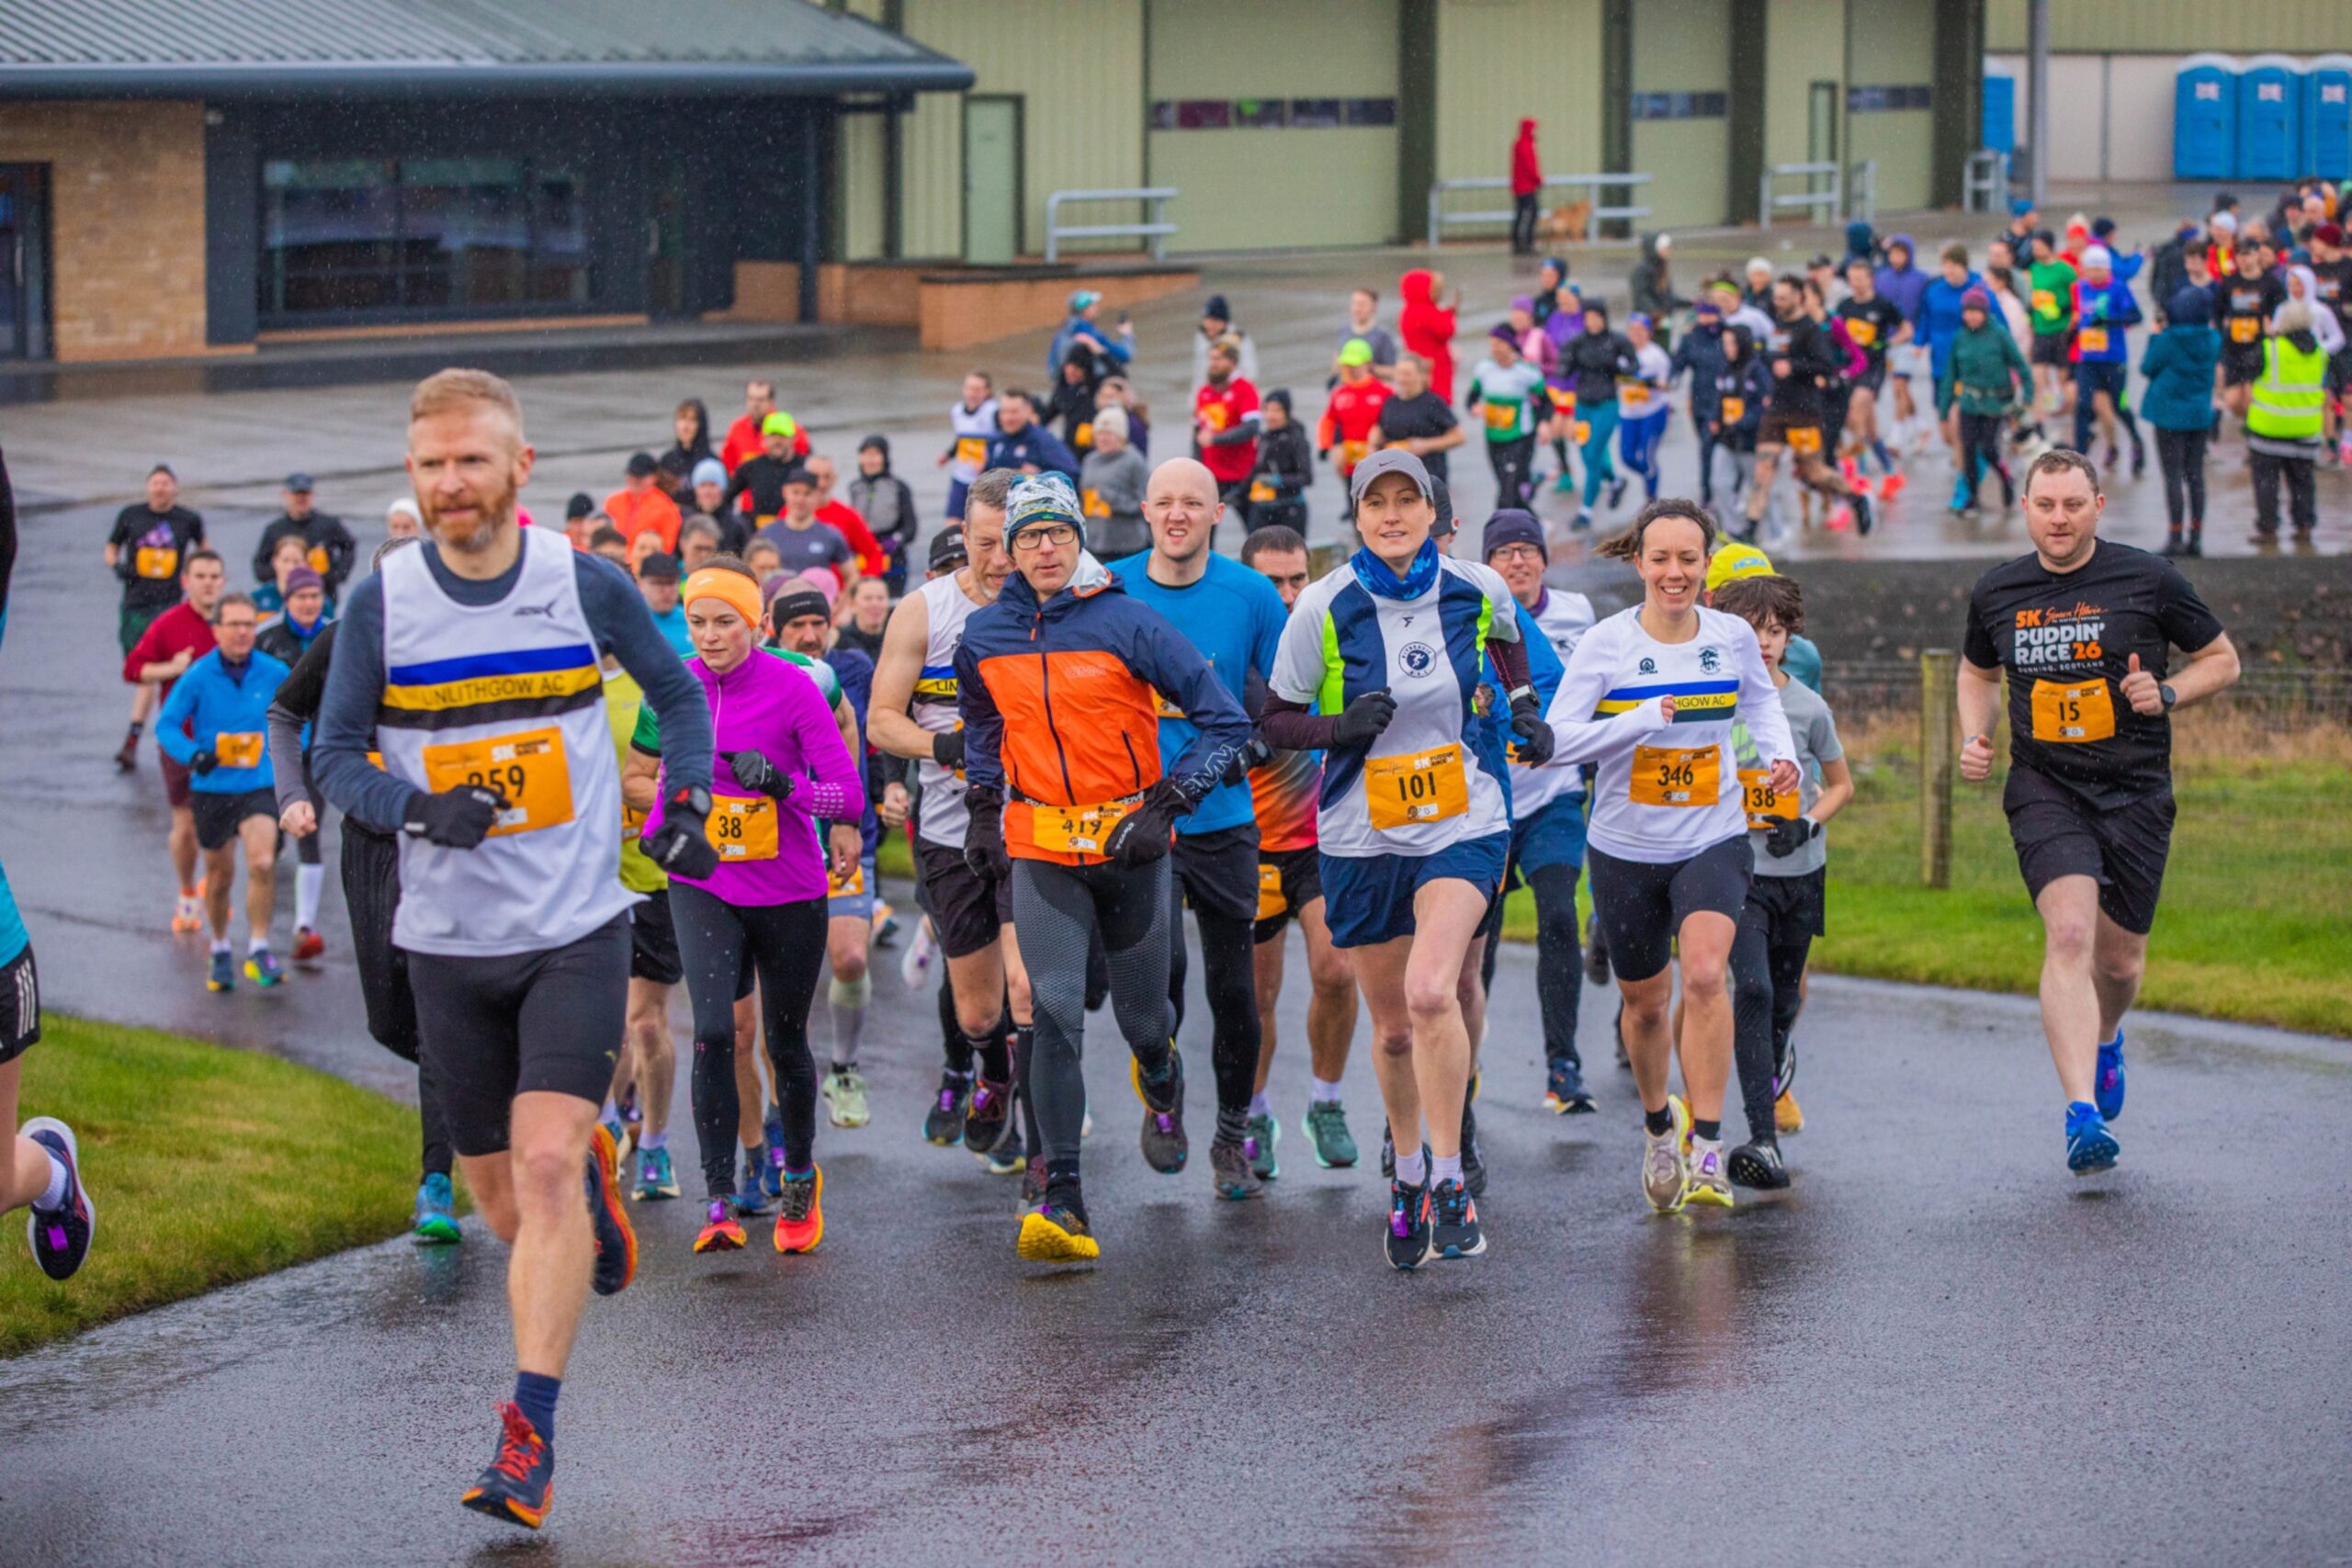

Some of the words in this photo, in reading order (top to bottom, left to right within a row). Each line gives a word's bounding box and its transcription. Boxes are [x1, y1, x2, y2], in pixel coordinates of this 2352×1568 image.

[2015, 609, 2041, 628] 5K
[2015, 622, 2106, 648] PUDDIN'
[2015, 643, 2072, 665] RACE
[2073, 640, 2102, 660] 26
[539, 674, 566, 694] AC
[935, 680, 958, 692] LIN
[1712, 694, 1726, 705] AC
[2058, 701, 2081, 722] 15
[1657, 763, 1694, 786] 346
[1397, 771, 1436, 802] 101
[718, 815, 742, 840] 38
[1062, 818, 1103, 836] 419
